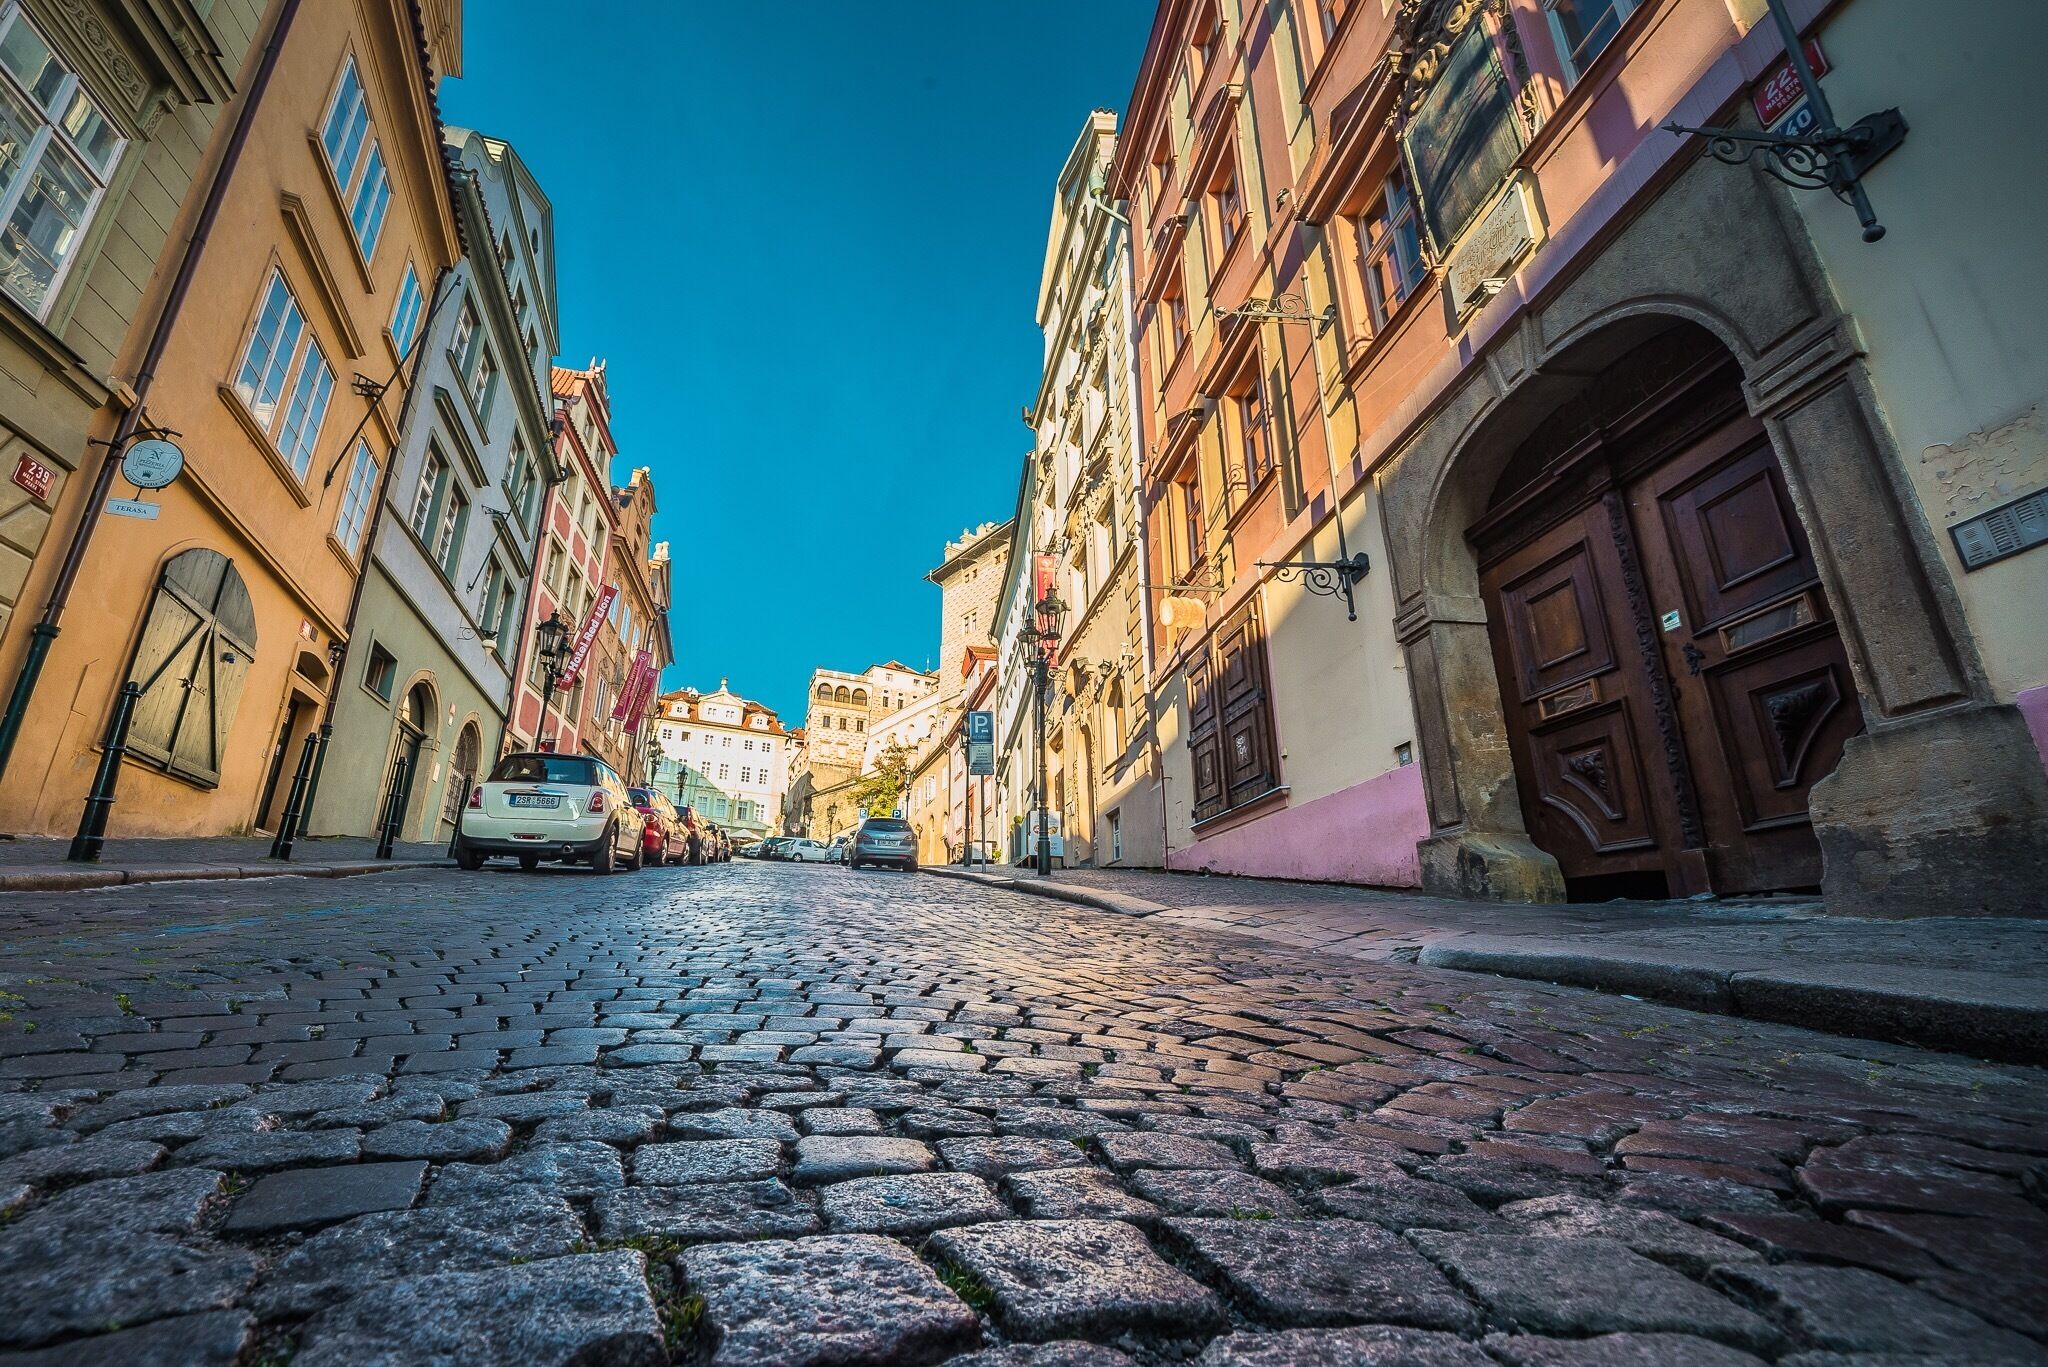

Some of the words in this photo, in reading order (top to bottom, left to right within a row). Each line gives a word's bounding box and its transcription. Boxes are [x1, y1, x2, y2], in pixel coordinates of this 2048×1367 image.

[1764, 62, 1798, 100] 22
[1765, 91, 1784, 111] MALÁ
[1776, 86, 1801, 108] PRAHA
[22, 471, 35, 482] MALÁ
[34, 479, 47, 490] STRANA
[28, 461, 50, 483] 239
[24, 479, 38, 491] PRAHA
[115, 504, 147, 515] TERASA
[568, 641, 589, 672] Hotel
[582, 618, 600, 642] Red
[594, 595, 612, 619] Lion
[975, 715, 988, 734] P
[516, 796, 532, 804] 2SR
[536, 797, 556, 805] 5666
[893, 810, 901, 818] P
